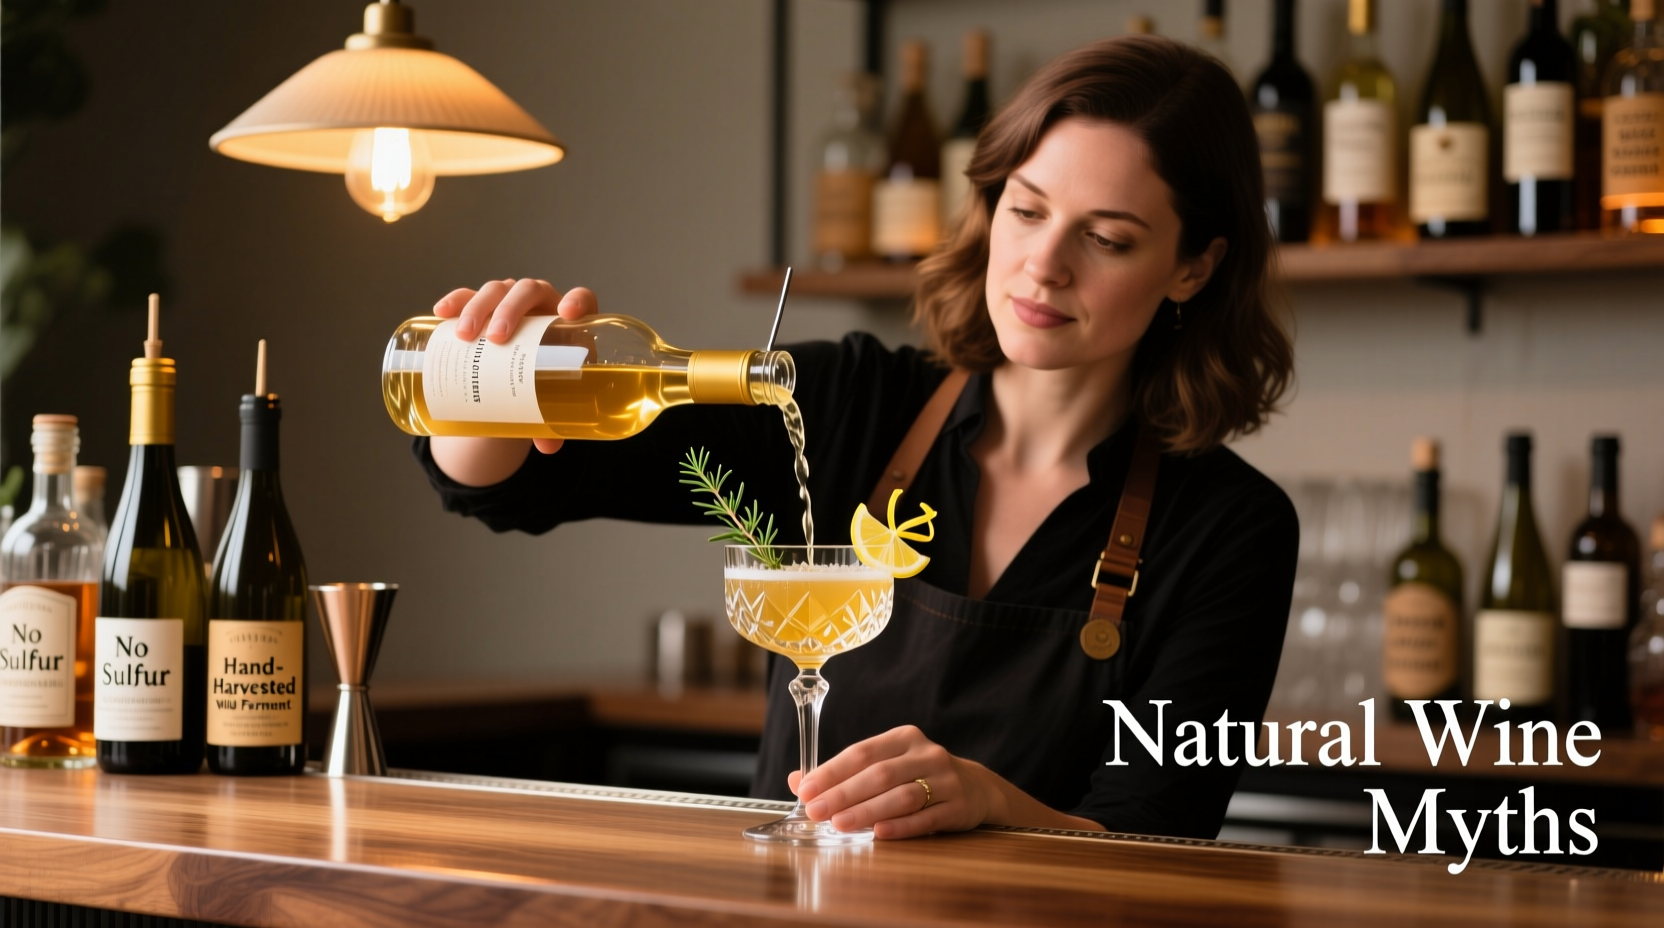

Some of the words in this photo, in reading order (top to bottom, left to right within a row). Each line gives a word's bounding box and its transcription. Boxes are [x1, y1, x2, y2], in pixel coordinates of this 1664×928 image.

[13, 624, 42, 644] No
[115, 636, 149, 658] No
[0, 648, 64, 671] Sulfur
[224, 656, 284, 675] Hand-
[102, 663, 171, 687] Sulfur
[213, 676, 296, 695] Harvested
